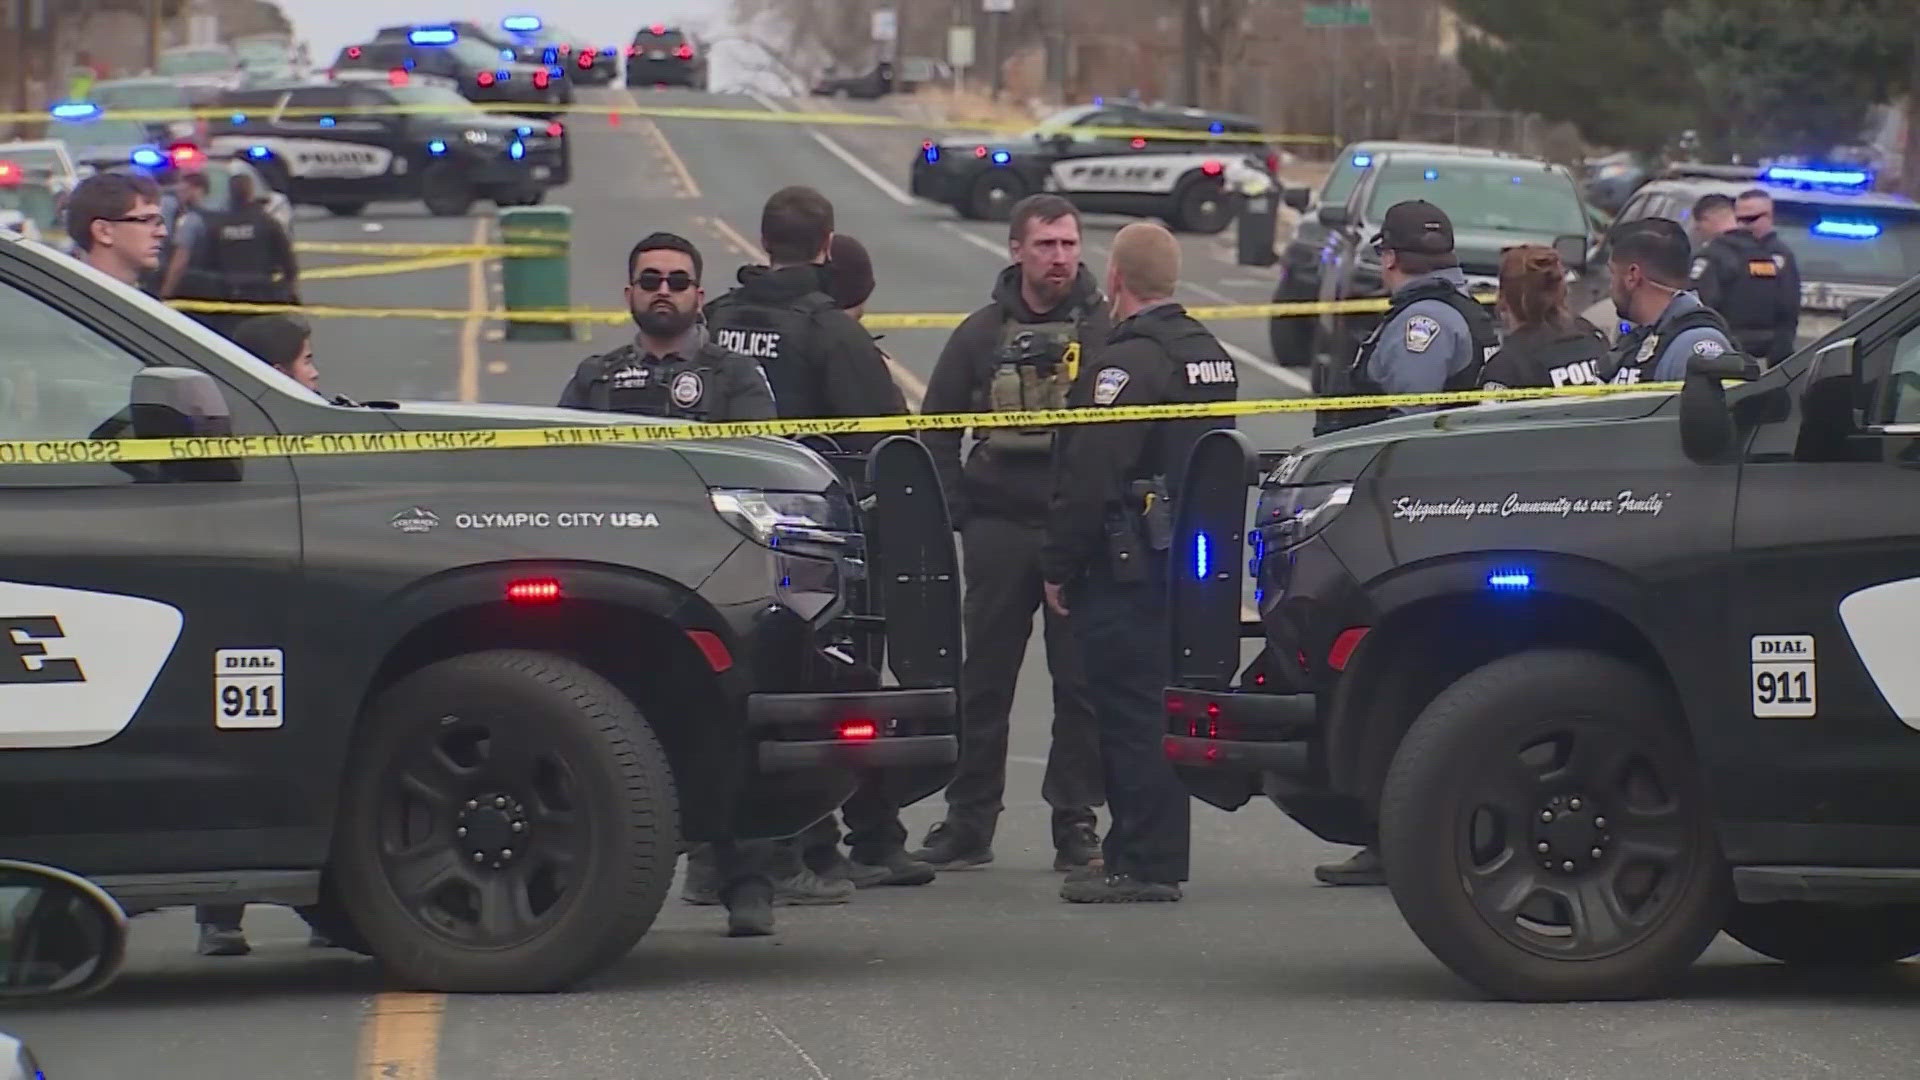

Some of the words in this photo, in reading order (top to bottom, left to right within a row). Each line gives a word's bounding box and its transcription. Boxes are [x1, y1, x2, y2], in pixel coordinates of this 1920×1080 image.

[1072, 166, 1168, 179] POLICE
[719, 329, 780, 358] POLICE
[1478, 502, 1498, 514] our
[1501, 492, 1572, 518] Community
[1573, 499, 1589, 512] as
[1590, 499, 1612, 512] our
[455, 513, 551, 529] OLYMPIC
[557, 512, 604, 527] CITY
[609, 512, 660, 528] USA
[1760, 640, 1807, 654] DIAL
[225, 657, 275, 669] DIAL
[1757, 671, 1812, 704] 911
[221, 685, 277, 717] 911
